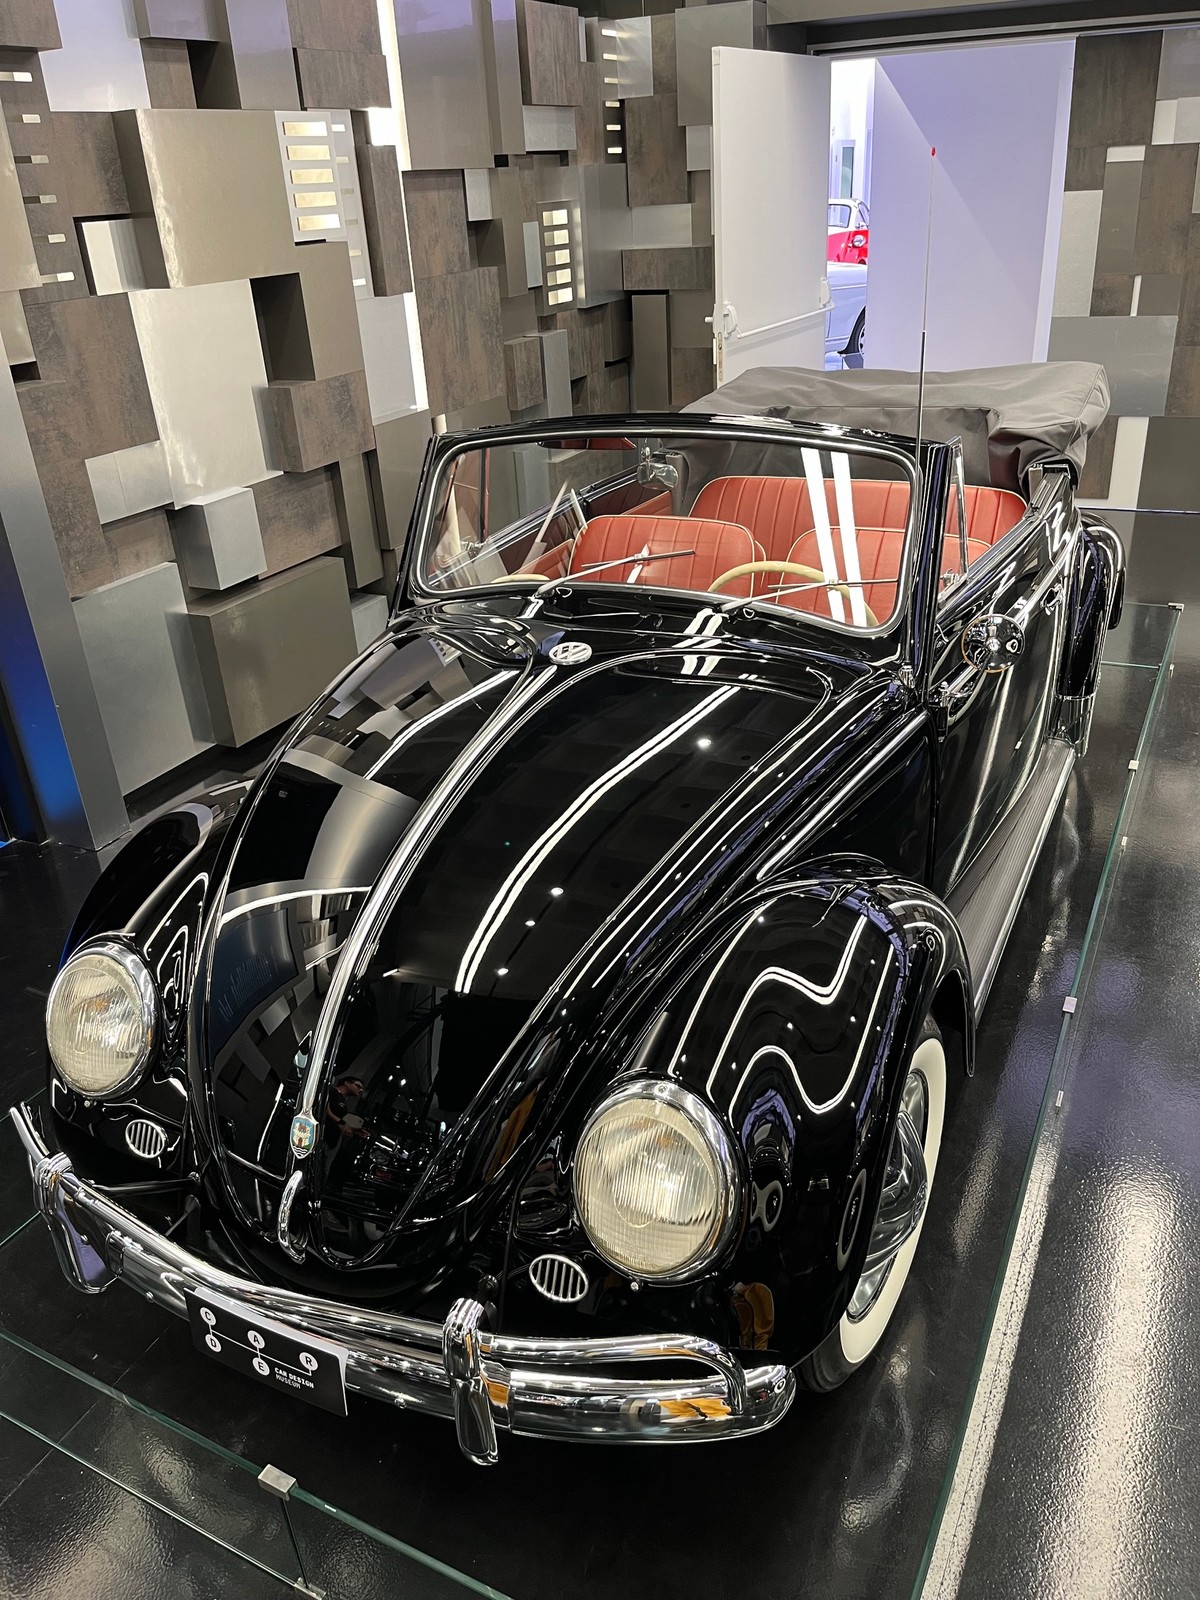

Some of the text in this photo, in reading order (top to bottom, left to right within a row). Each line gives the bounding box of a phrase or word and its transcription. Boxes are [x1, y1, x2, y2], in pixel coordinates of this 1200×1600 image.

[549, 641, 592, 662] VW
[274, 1367, 314, 1389] CAR DESIGN
[275, 1373, 301, 1389] MUSEUM
